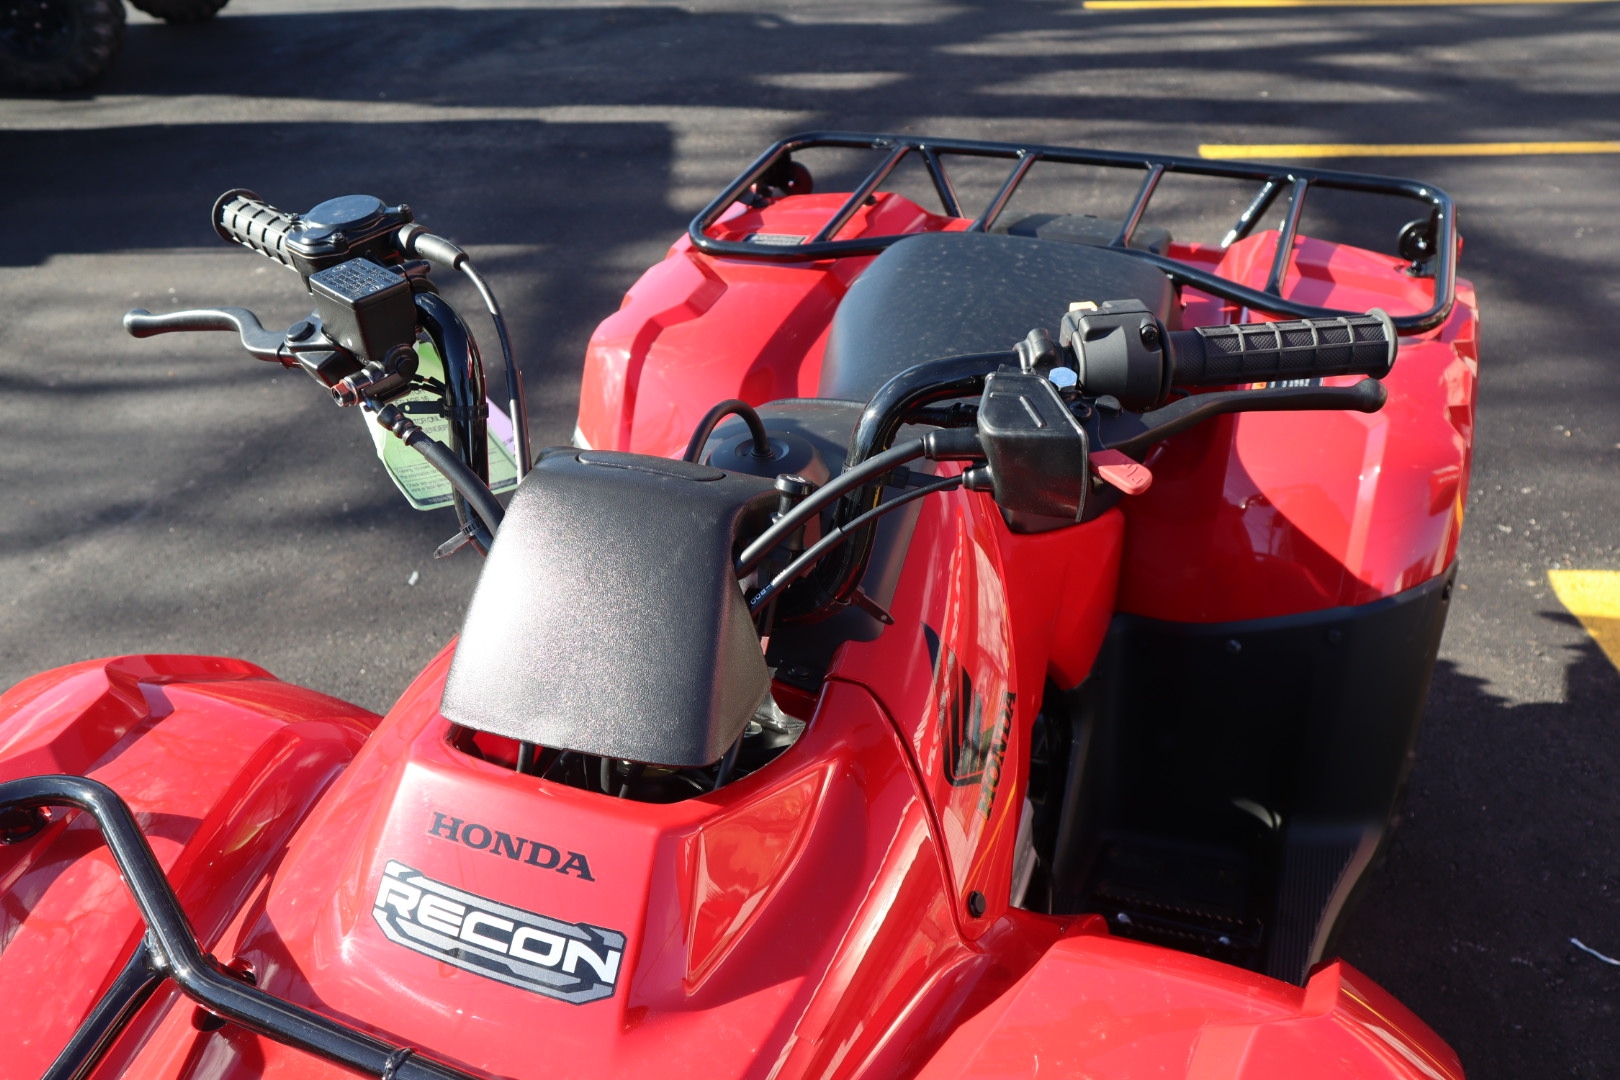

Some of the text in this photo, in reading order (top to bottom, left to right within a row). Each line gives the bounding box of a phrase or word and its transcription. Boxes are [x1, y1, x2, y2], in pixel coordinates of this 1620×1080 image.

[978, 691, 1016, 821] HONDA
[427, 811, 596, 882] HONDA
[374, 876, 623, 985] RECON
